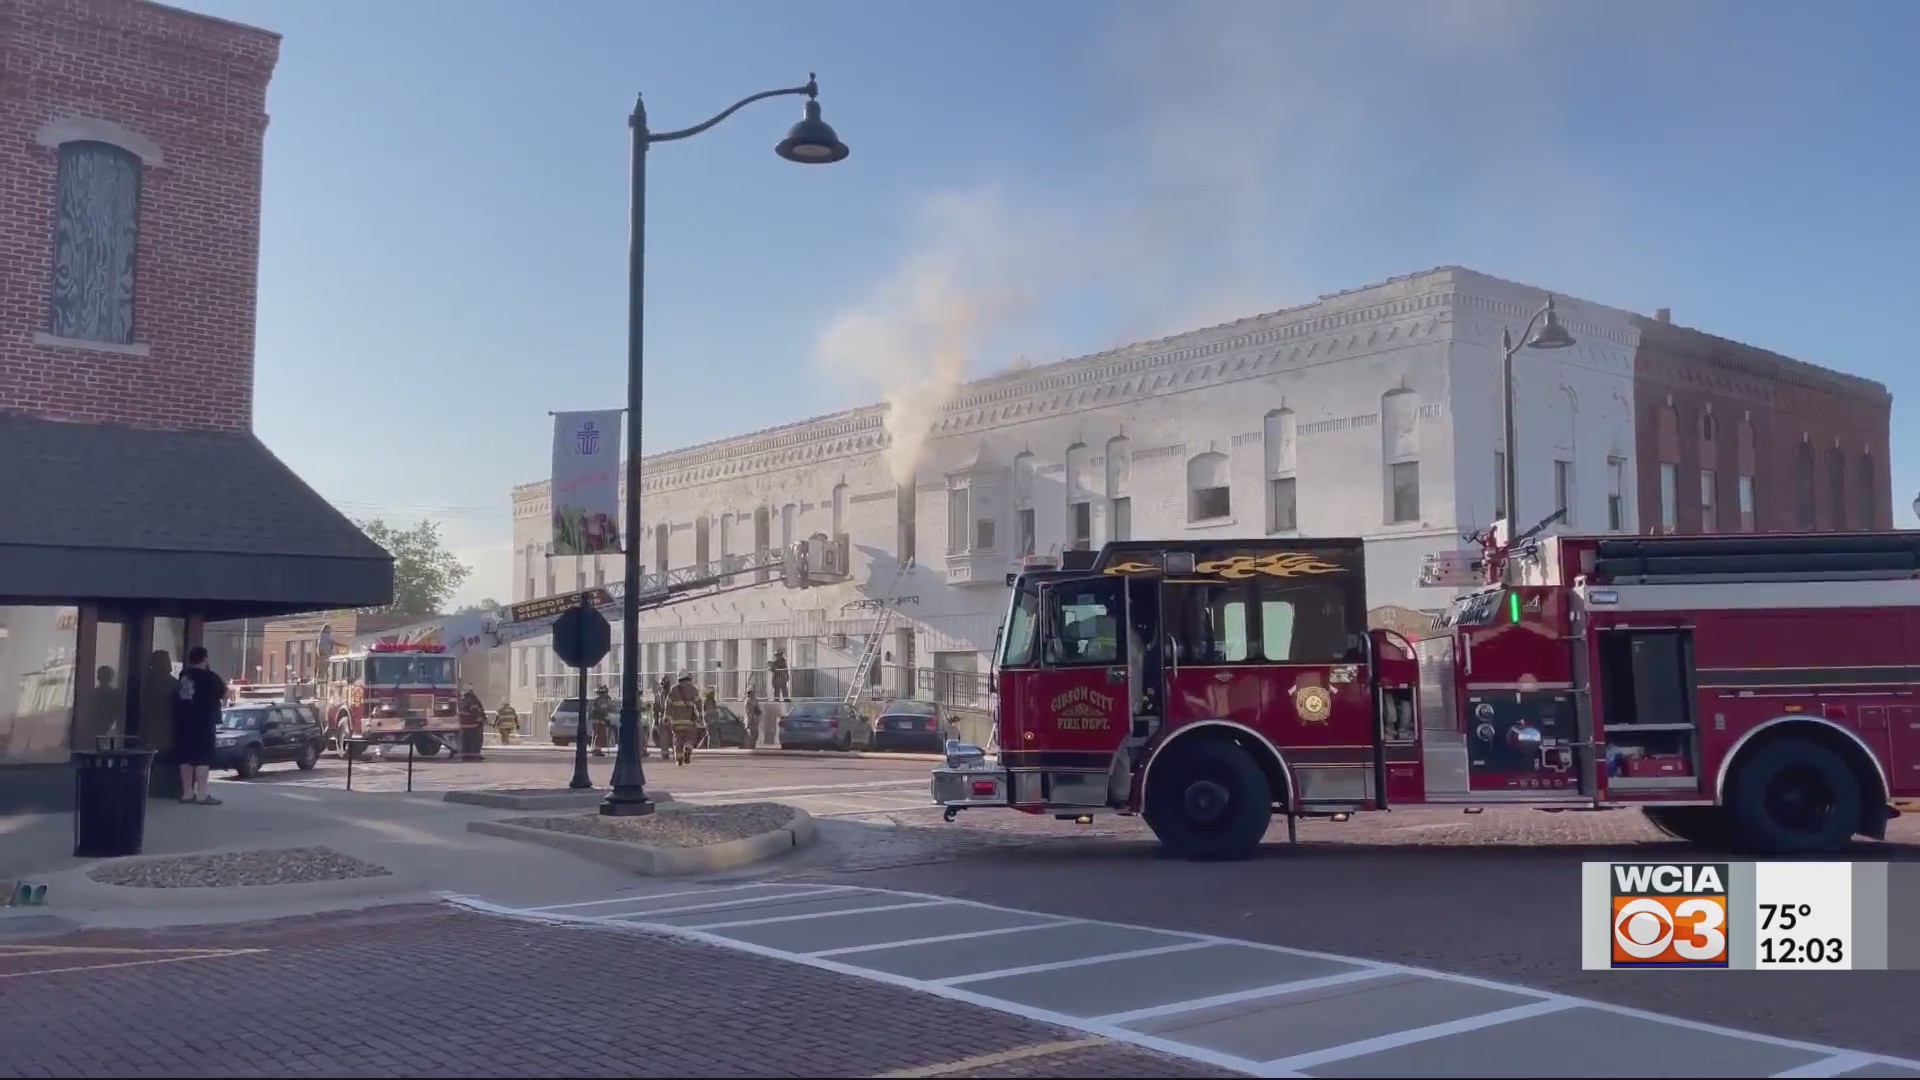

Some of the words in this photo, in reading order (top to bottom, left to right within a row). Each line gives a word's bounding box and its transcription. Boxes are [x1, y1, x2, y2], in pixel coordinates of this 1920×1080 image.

[1051, 686, 1089, 712] GIBSON
[1089, 690, 1115, 712] CITY
[1057, 717, 1080, 730] FIRE
[1081, 717, 1111, 730] DEPT.
